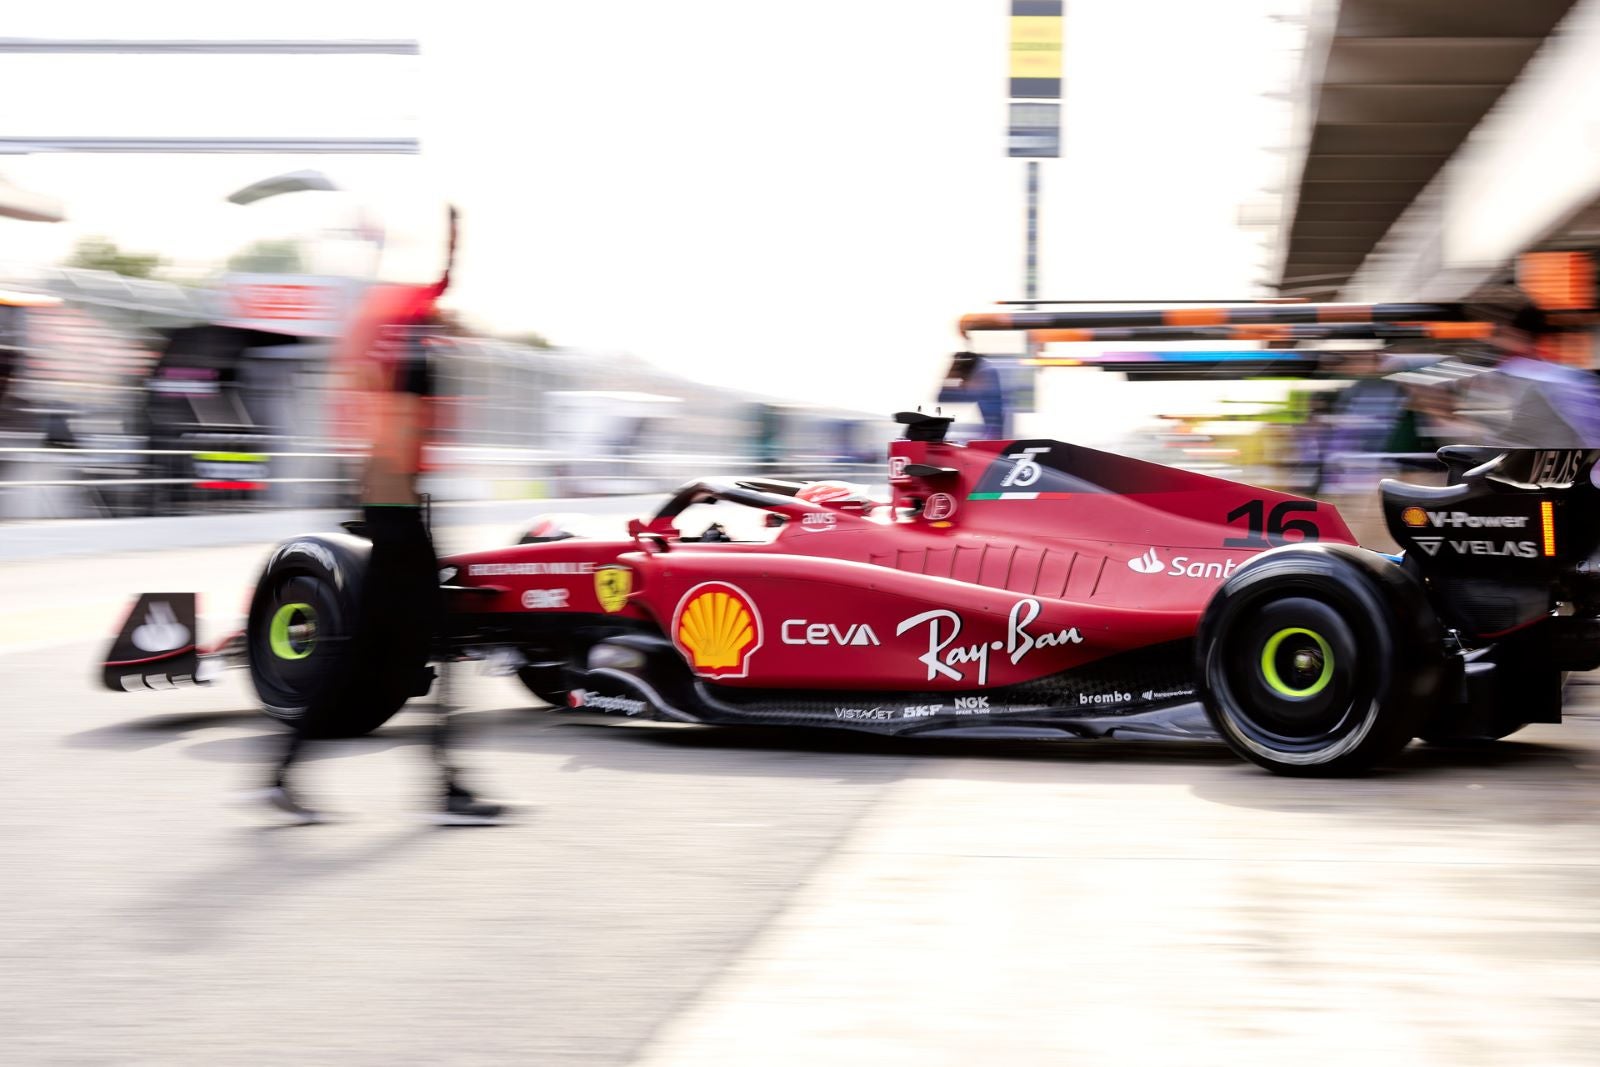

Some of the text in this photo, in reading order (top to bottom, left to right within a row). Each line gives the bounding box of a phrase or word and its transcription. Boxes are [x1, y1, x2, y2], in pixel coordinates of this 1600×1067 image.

[1529, 449, 1582, 484] VELAS
[802, 511, 836, 526] aws
[1223, 499, 1320, 548] 16
[1428, 511, 1531, 528] V-Power
[1448, 540, 1538, 558] VELAS
[954, 696, 989, 710] NGK
[1079, 690, 1132, 704] brembo
[903, 704, 944, 719] SKF
